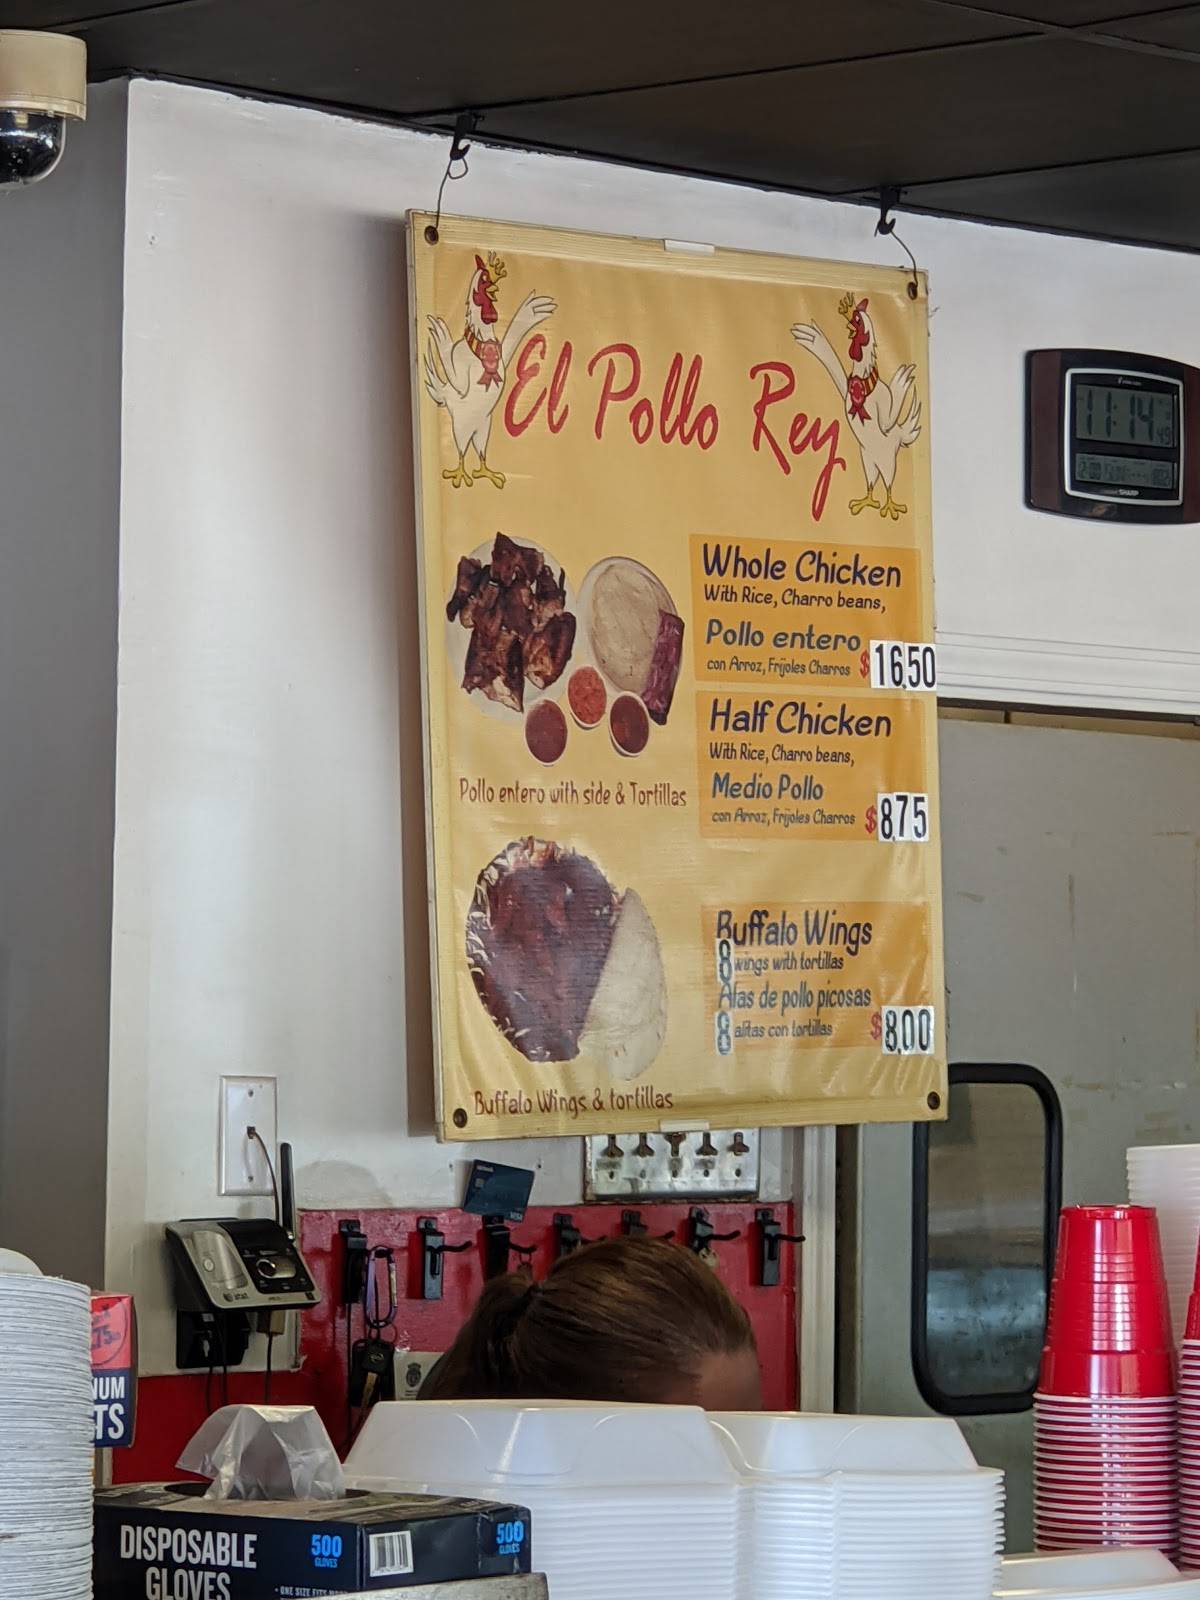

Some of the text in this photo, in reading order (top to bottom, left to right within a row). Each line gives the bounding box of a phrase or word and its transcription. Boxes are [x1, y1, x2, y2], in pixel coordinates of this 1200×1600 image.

[504, 334, 846, 522] El Pollo Rey
[703, 543, 901, 587] Whole Chicken
[704, 584, 886, 614] With Rice, Charro beans,
[705, 618, 861, 651] Pollo entero
[707, 656, 850, 678] con Arroz, Frijoles Charros
[710, 698, 892, 738] Half Chicken
[709, 742, 855, 767] With Rice, Charro beans,
[460, 777, 687, 807] Pollo entero with side & Tortillas
[712, 772, 824, 800] Medio Pollo
[711, 808, 856, 828] con Arroz, Frijoles Charros
[716, 909, 873, 956] Buffalo Wings
[734, 952, 768, 976] wings
[772, 952, 798, 970] with
[800, 951, 844, 970] tortillas
[718, 981, 872, 1016] Alas de pollo picosas
[734, 1020, 764, 1038] alitas
[768, 1025, 789, 1037] con
[792, 1018, 833, 1036] tortillas
[474, 1085, 673, 1119] Buffalo Wings & tortillas
[120, 1524, 258, 1569] DISPOSABLE
[311, 1534, 343, 1558] 500
[496, 1520, 524, 1544] 500
[315, 1557, 338, 1568] GLOVES
[499, 1544, 521, 1555] GLOVES
[145, 1566, 231, 1600] GLOVES
